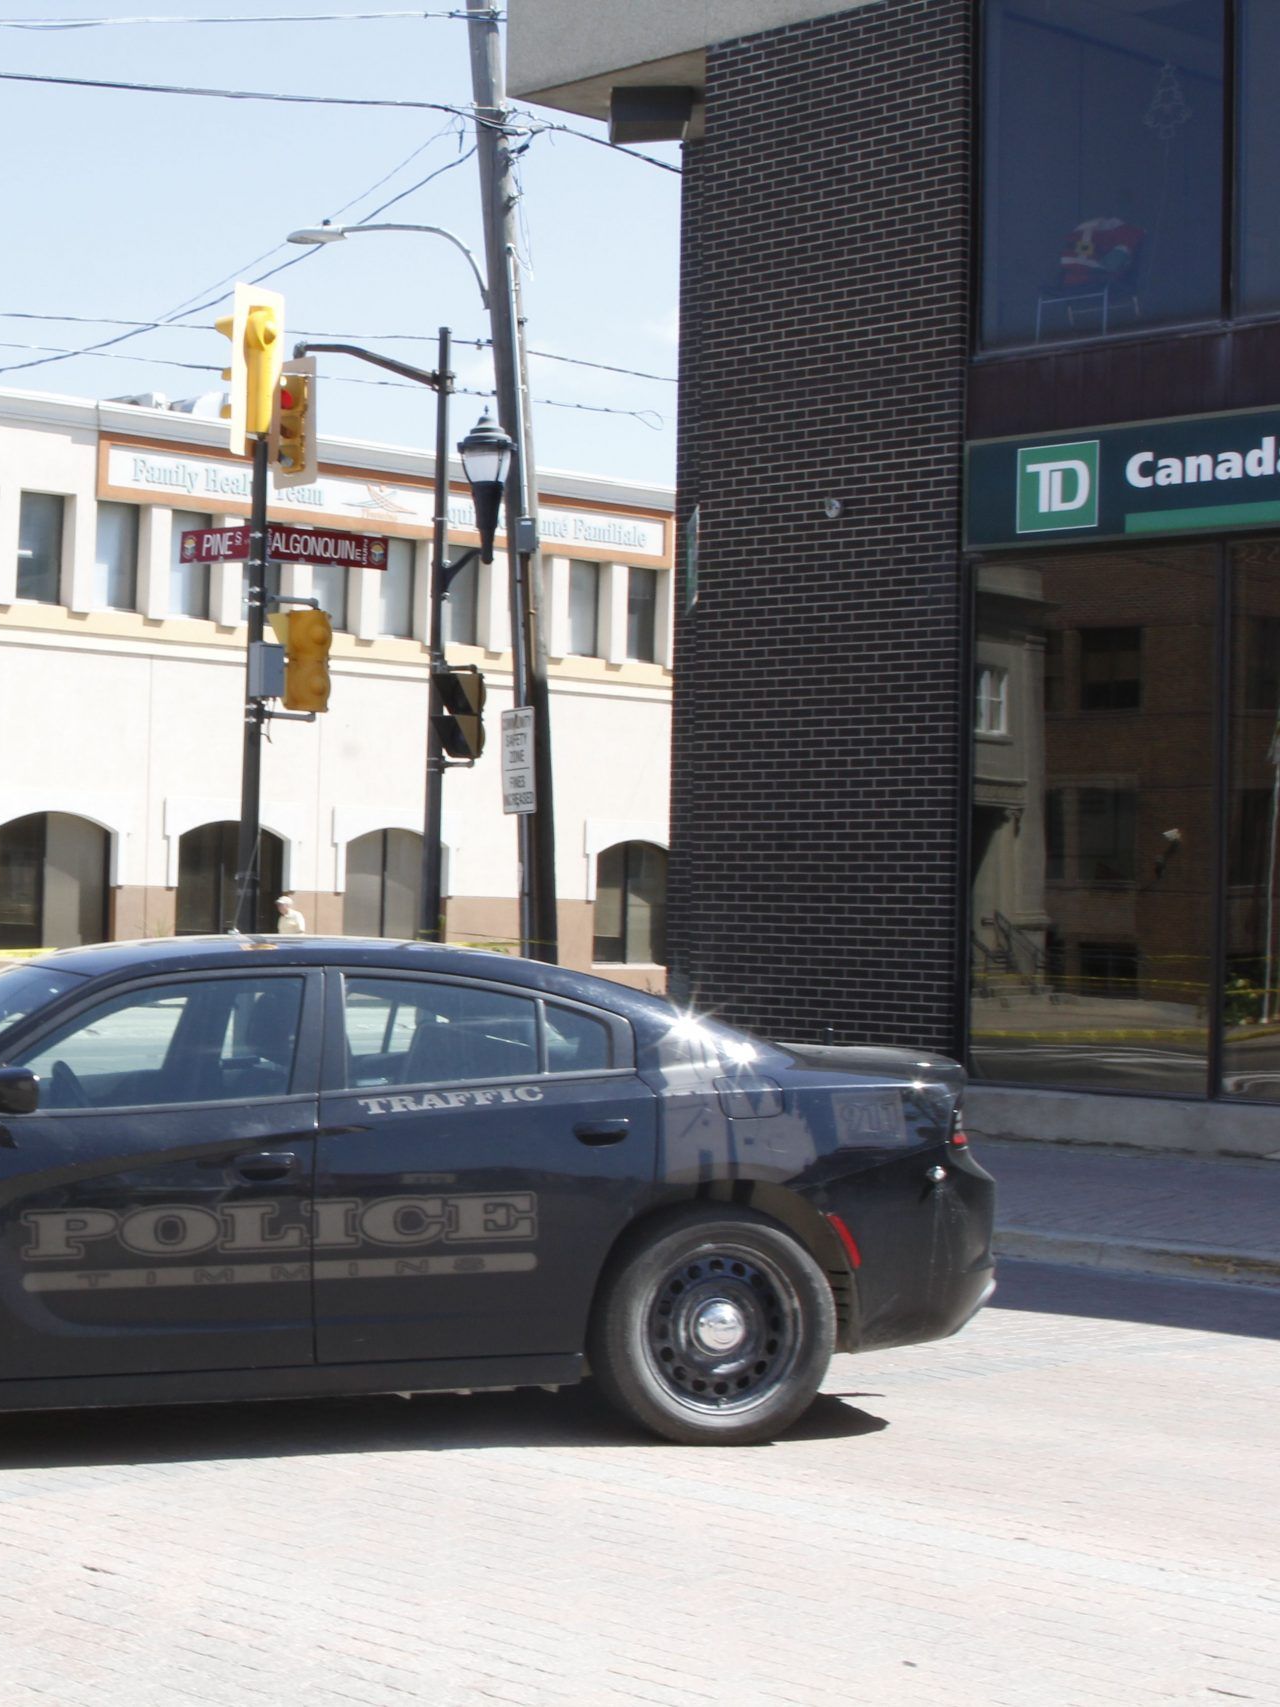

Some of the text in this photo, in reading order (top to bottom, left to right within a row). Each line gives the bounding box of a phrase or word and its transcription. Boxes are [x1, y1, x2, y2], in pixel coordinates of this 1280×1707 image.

[132, 458, 198, 493] Family
[205, 467, 253, 497] Heal
[1025, 436, 1280, 514] TD Canad
[202, 532, 234, 557] PINE
[271, 532, 355, 561] ALGONQUIN
[572, 518, 648, 548] Familiale
[505, 732, 528, 748] SAFETY
[508, 749, 525, 764] ZONE
[509, 775, 526, 789] FINES
[358, 1086, 544, 1115] TRAFFIC
[839, 1102, 897, 1132] 911
[24, 1191, 539, 1263] POLICE
[78, 1256, 487, 1290] TIMMINS
